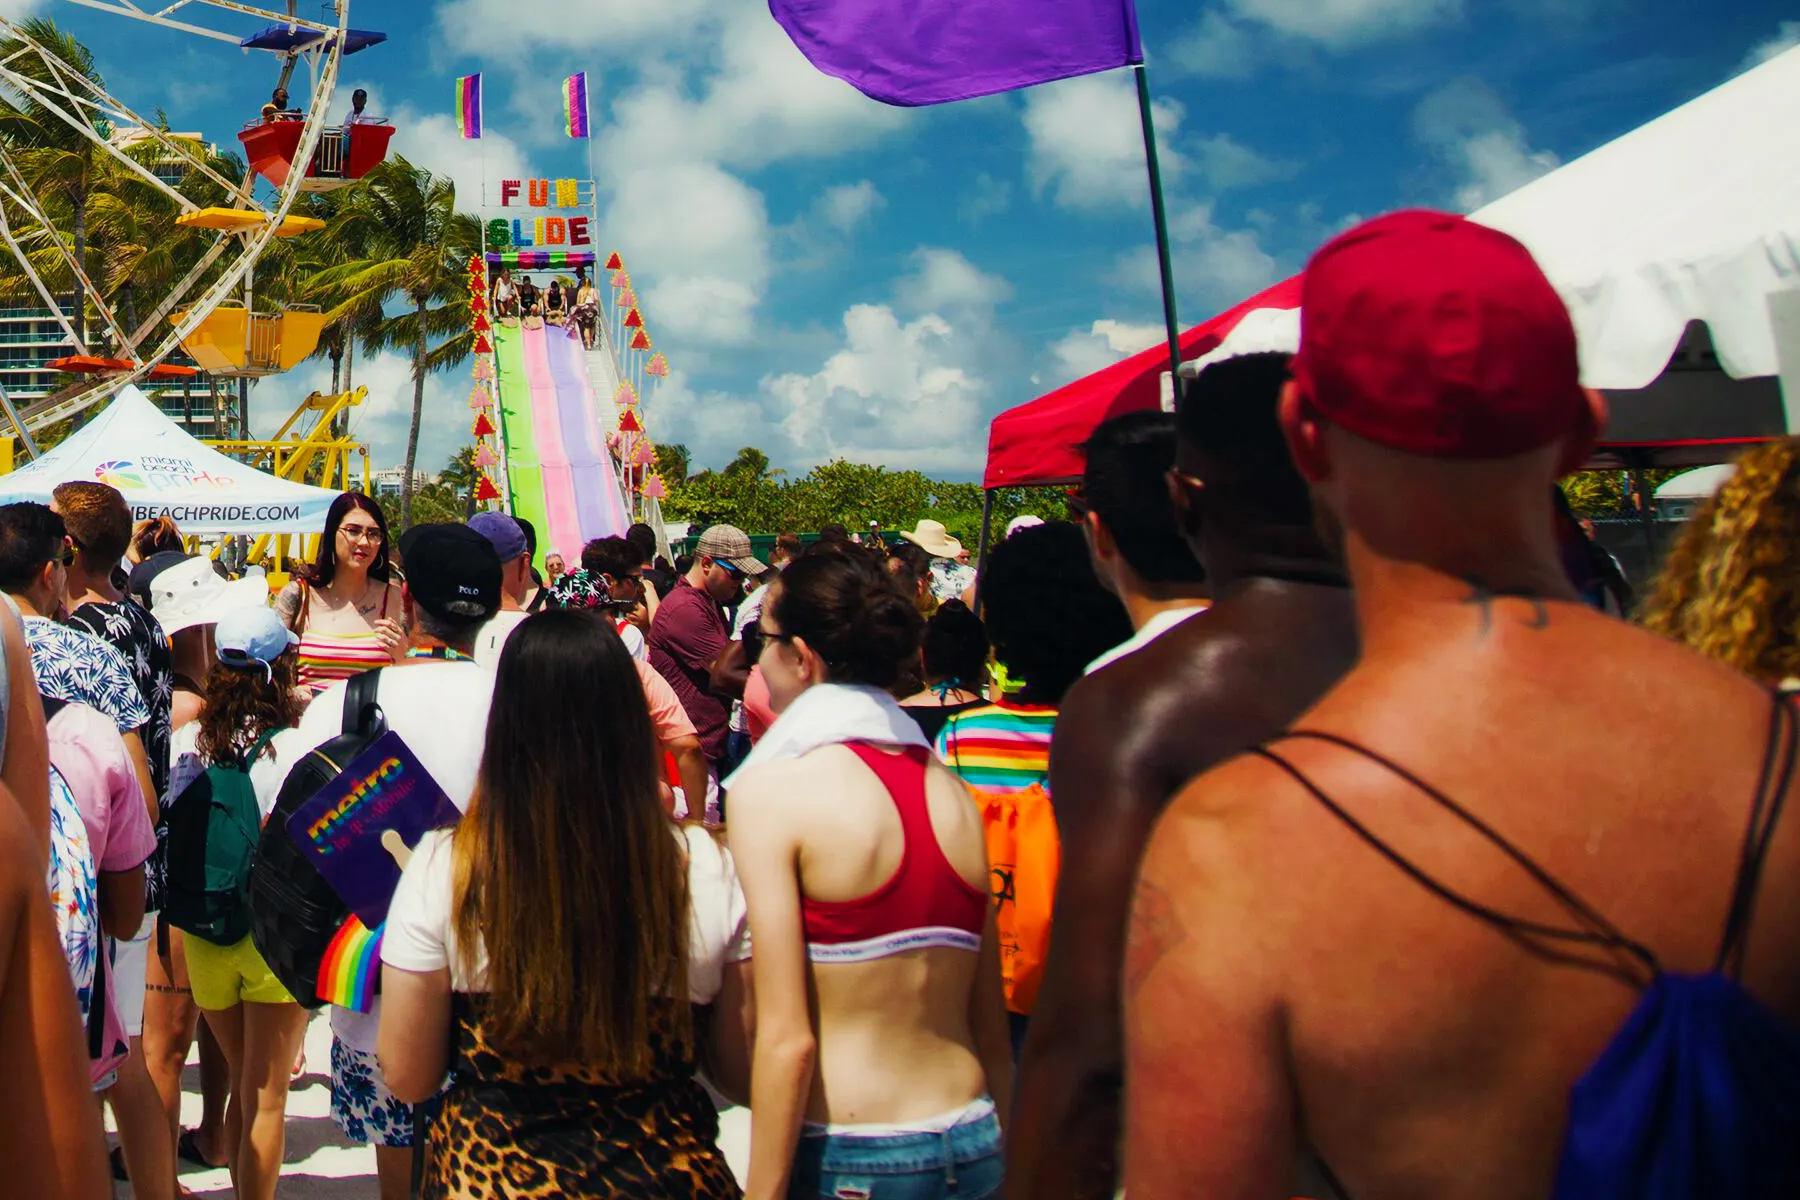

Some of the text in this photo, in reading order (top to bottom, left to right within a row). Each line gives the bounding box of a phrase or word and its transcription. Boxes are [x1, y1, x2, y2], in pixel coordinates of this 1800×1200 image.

[501, 178, 578, 208] FUN
[487, 216, 591, 247] SLIDE
[140, 455, 193, 467] miami
[142, 462, 196, 475] beach
[148, 470, 240, 493] pride
[131, 505, 300, 521] IBEACHPRIDE.COM
[458, 585, 479, 596] POLO
[307, 757, 405, 845] metro
